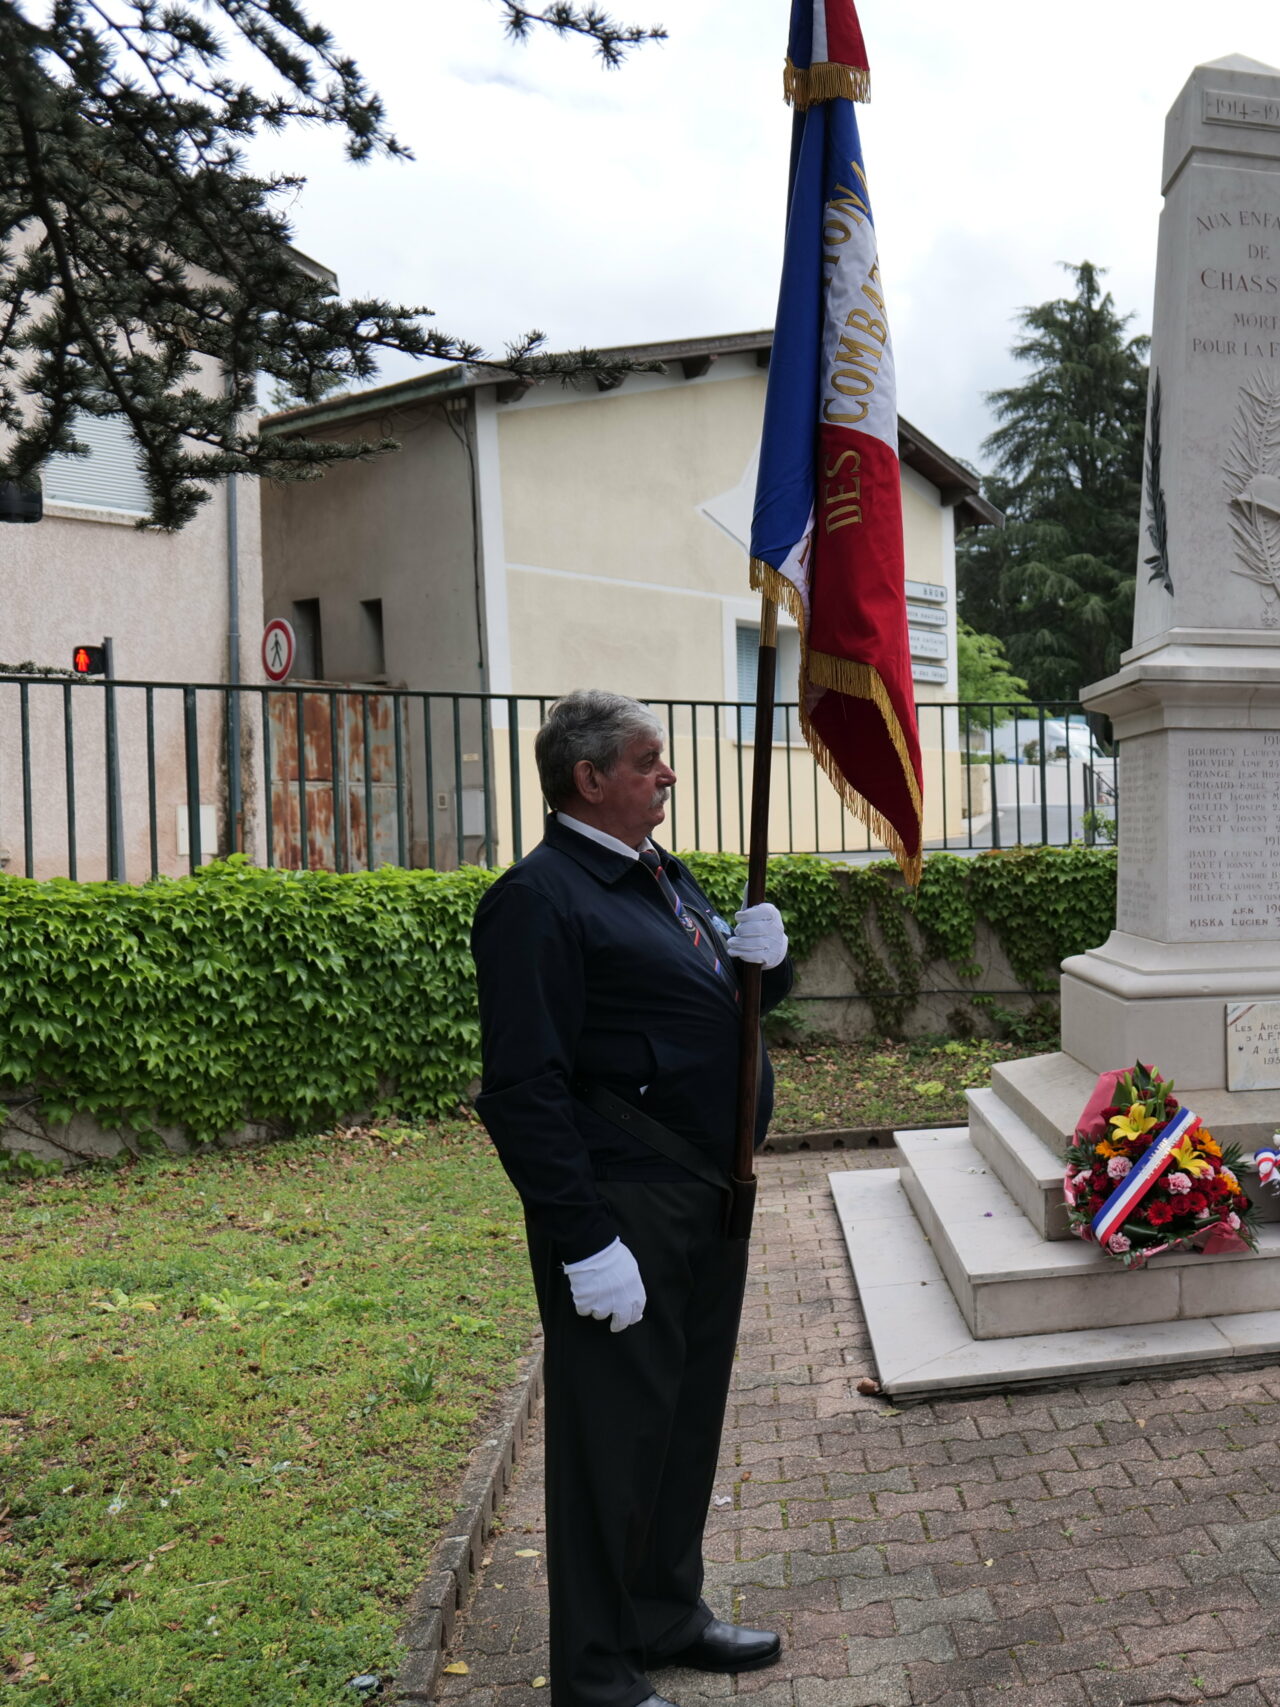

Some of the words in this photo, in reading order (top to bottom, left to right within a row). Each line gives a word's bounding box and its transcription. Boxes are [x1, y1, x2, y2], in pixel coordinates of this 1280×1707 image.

[1196, 212, 1232, 235] AUX
[1248, 243, 1271, 261] DE
[1193, 337, 1237, 356] POUR
[1244, 340, 1264, 358] LA
[824, 449, 861, 536] DES
[1189, 918, 1225, 929] KISKA
[1231, 917, 1269, 927] LUCIEN
